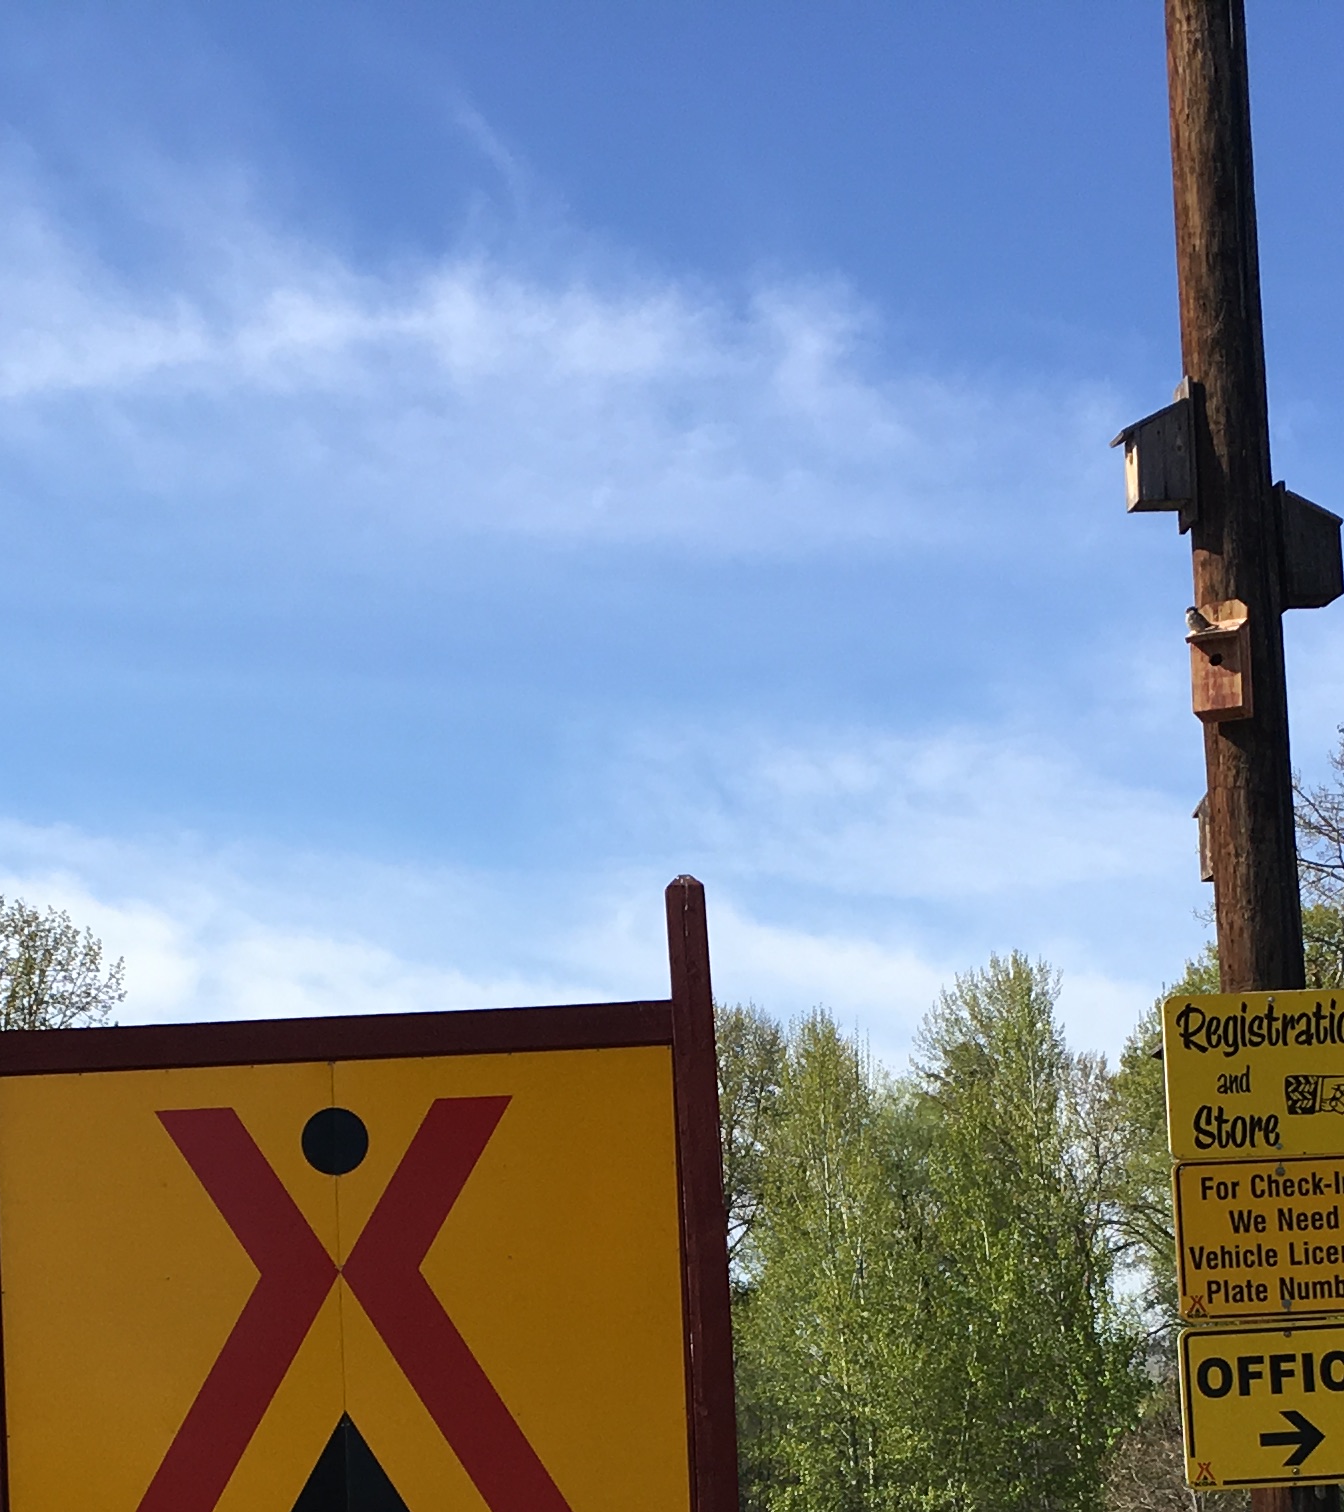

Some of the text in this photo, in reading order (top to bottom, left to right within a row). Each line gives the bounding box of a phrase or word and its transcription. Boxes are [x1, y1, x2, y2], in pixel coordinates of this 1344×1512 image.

[1216, 1064, 1252, 1095] and
[1193, 1104, 1281, 1150] Store
[1200, 1176, 1240, 1201] For
[1228, 1205, 1340, 1235] We Need
[1188, 1243, 1279, 1271] Vehicle
[1206, 1279, 1269, 1305] Plate
